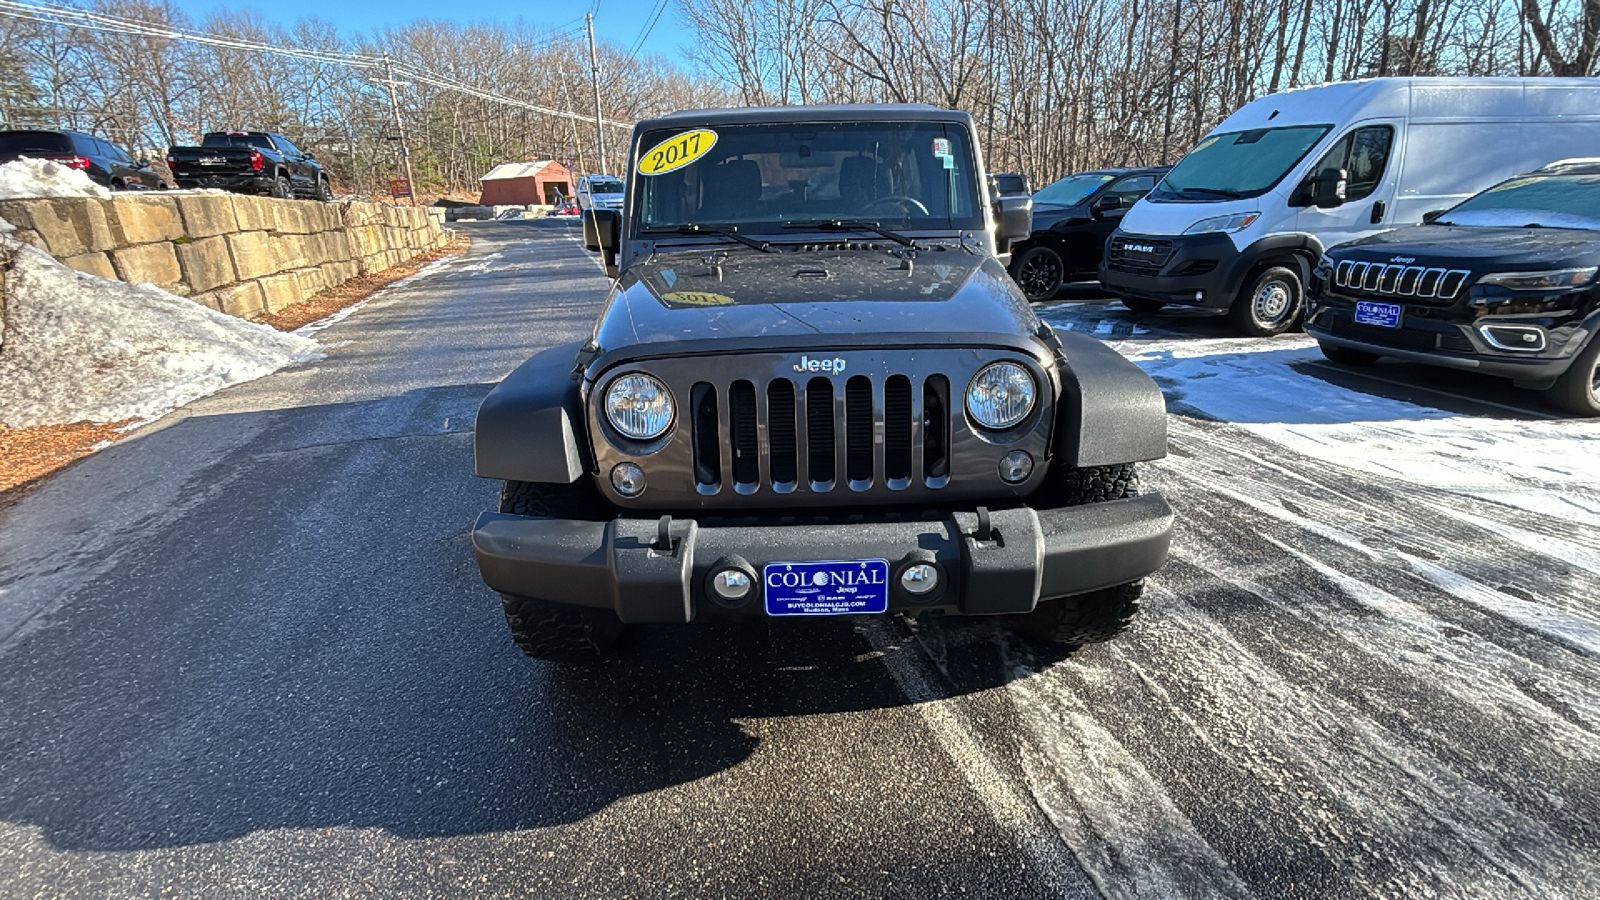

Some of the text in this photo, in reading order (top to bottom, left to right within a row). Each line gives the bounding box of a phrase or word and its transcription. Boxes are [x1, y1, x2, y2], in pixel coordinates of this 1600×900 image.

[652, 133, 702, 172] 2017
[1124, 244, 1154, 253] RAM
[1390, 256, 1415, 264] Jeep
[1358, 305, 1398, 315] COLONIAL
[792, 355, 846, 376] Jeep
[767, 570, 885, 588] COLONIAL
[836, 586, 858, 594] Jeep
